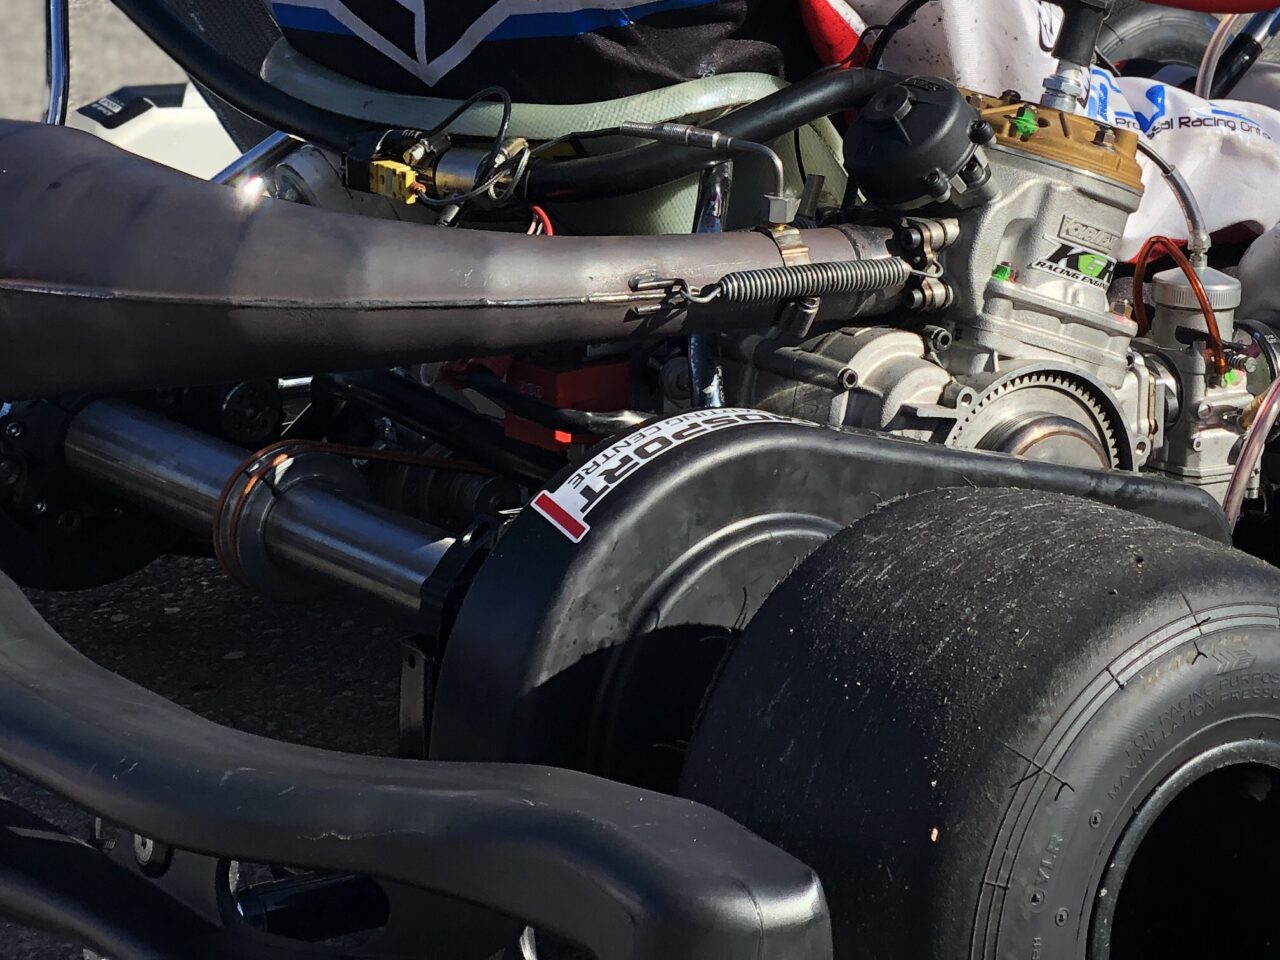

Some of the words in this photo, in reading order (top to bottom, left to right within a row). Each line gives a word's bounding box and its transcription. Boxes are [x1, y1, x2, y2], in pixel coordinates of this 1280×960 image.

[1178, 115, 1237, 131] Racing
[1034, 259, 1081, 281] RACING
[567, 426, 659, 489] CENTRE
